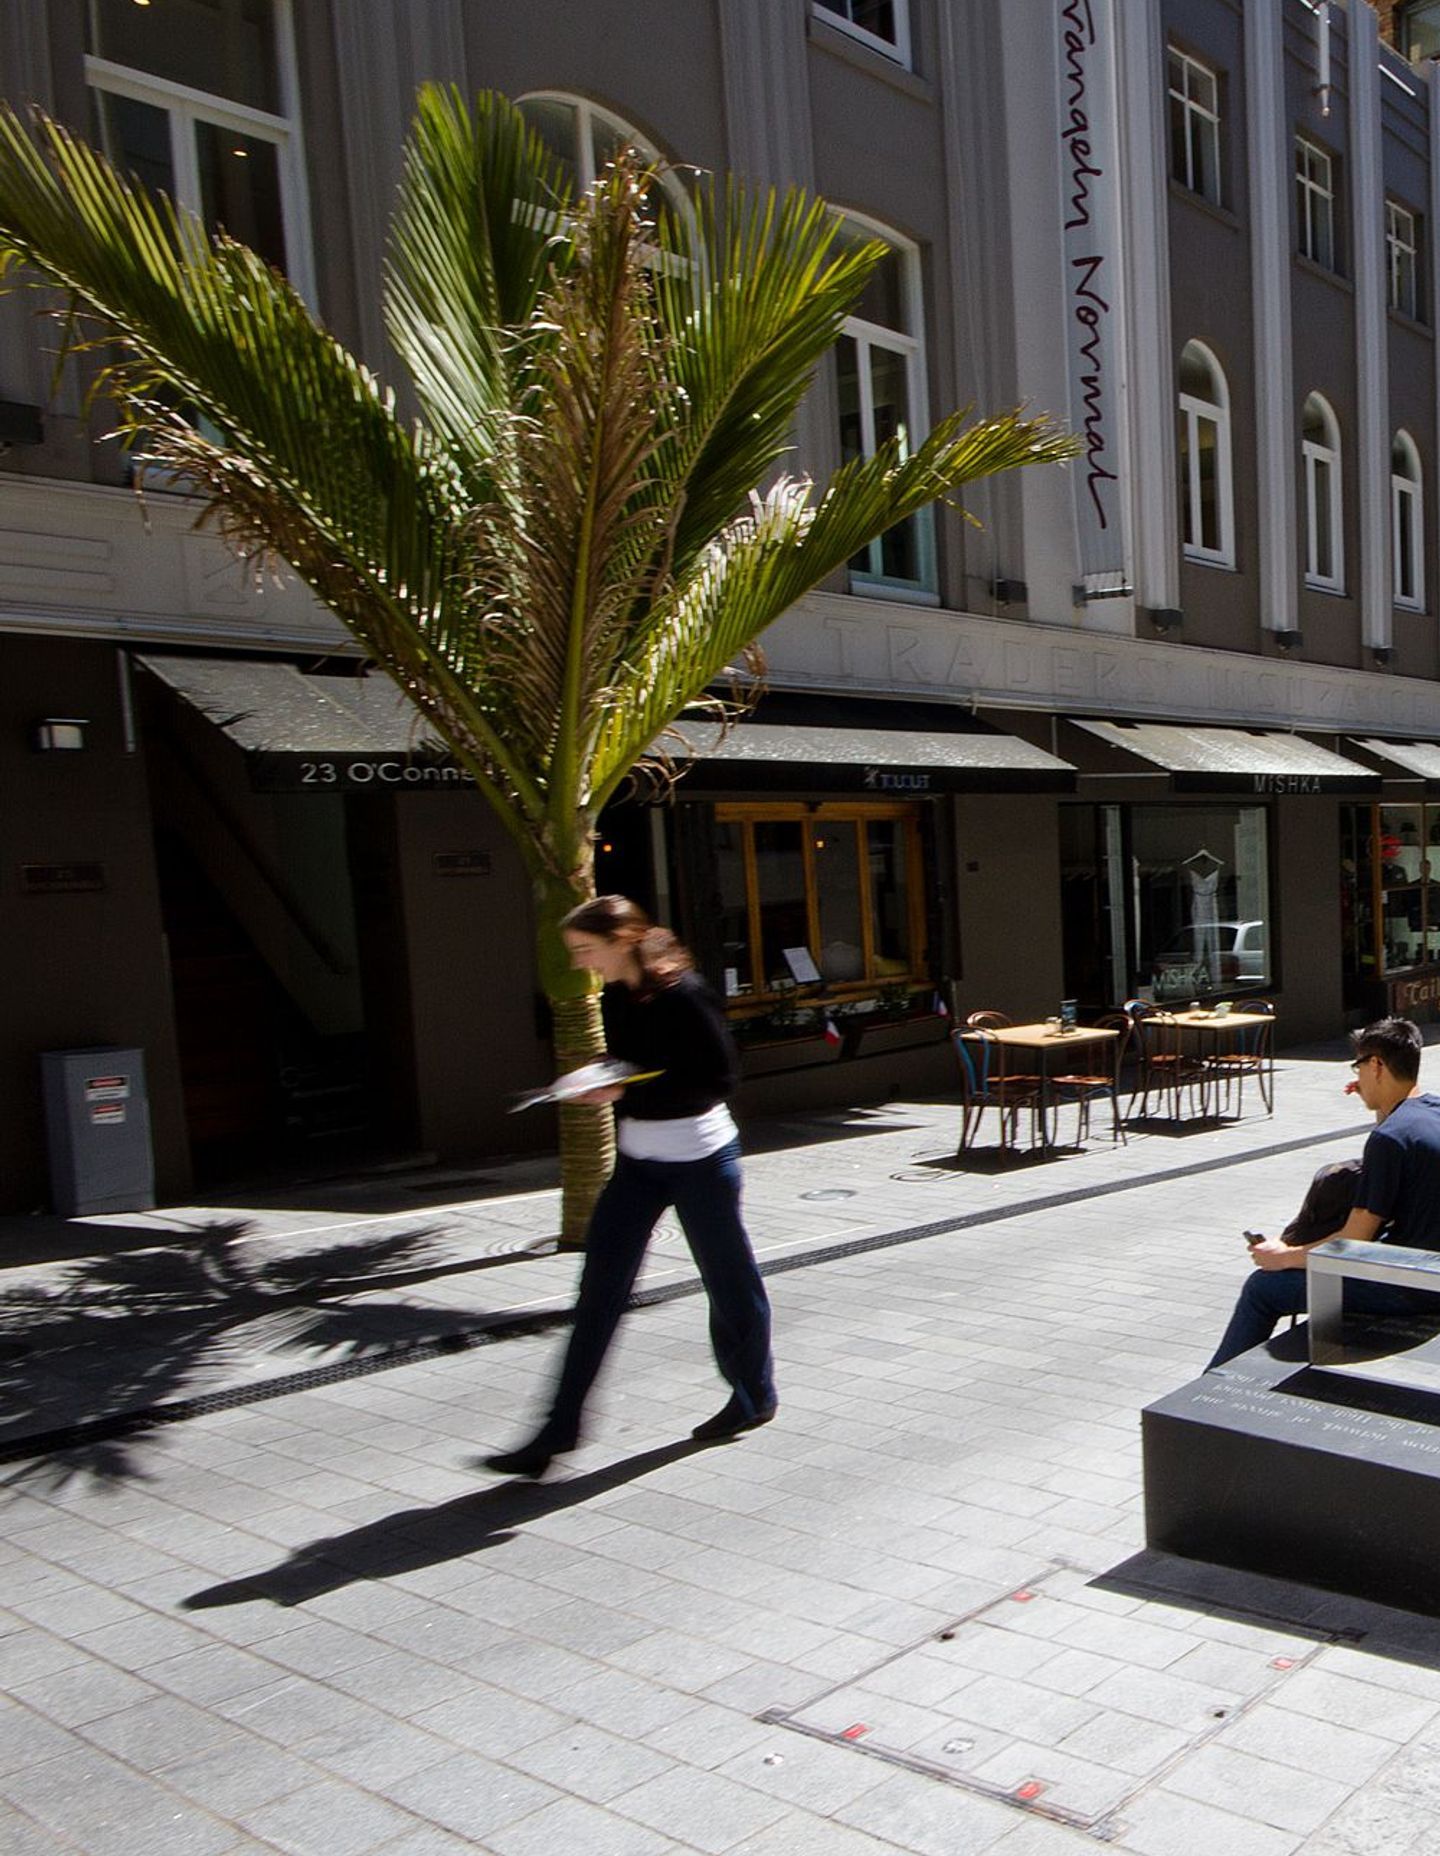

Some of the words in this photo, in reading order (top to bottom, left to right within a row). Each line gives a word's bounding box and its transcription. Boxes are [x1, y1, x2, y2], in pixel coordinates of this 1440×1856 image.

[301, 762, 337, 783] 23
[1331, 1408, 1374, 1423] High
[1321, 1422, 1389, 1442] network
